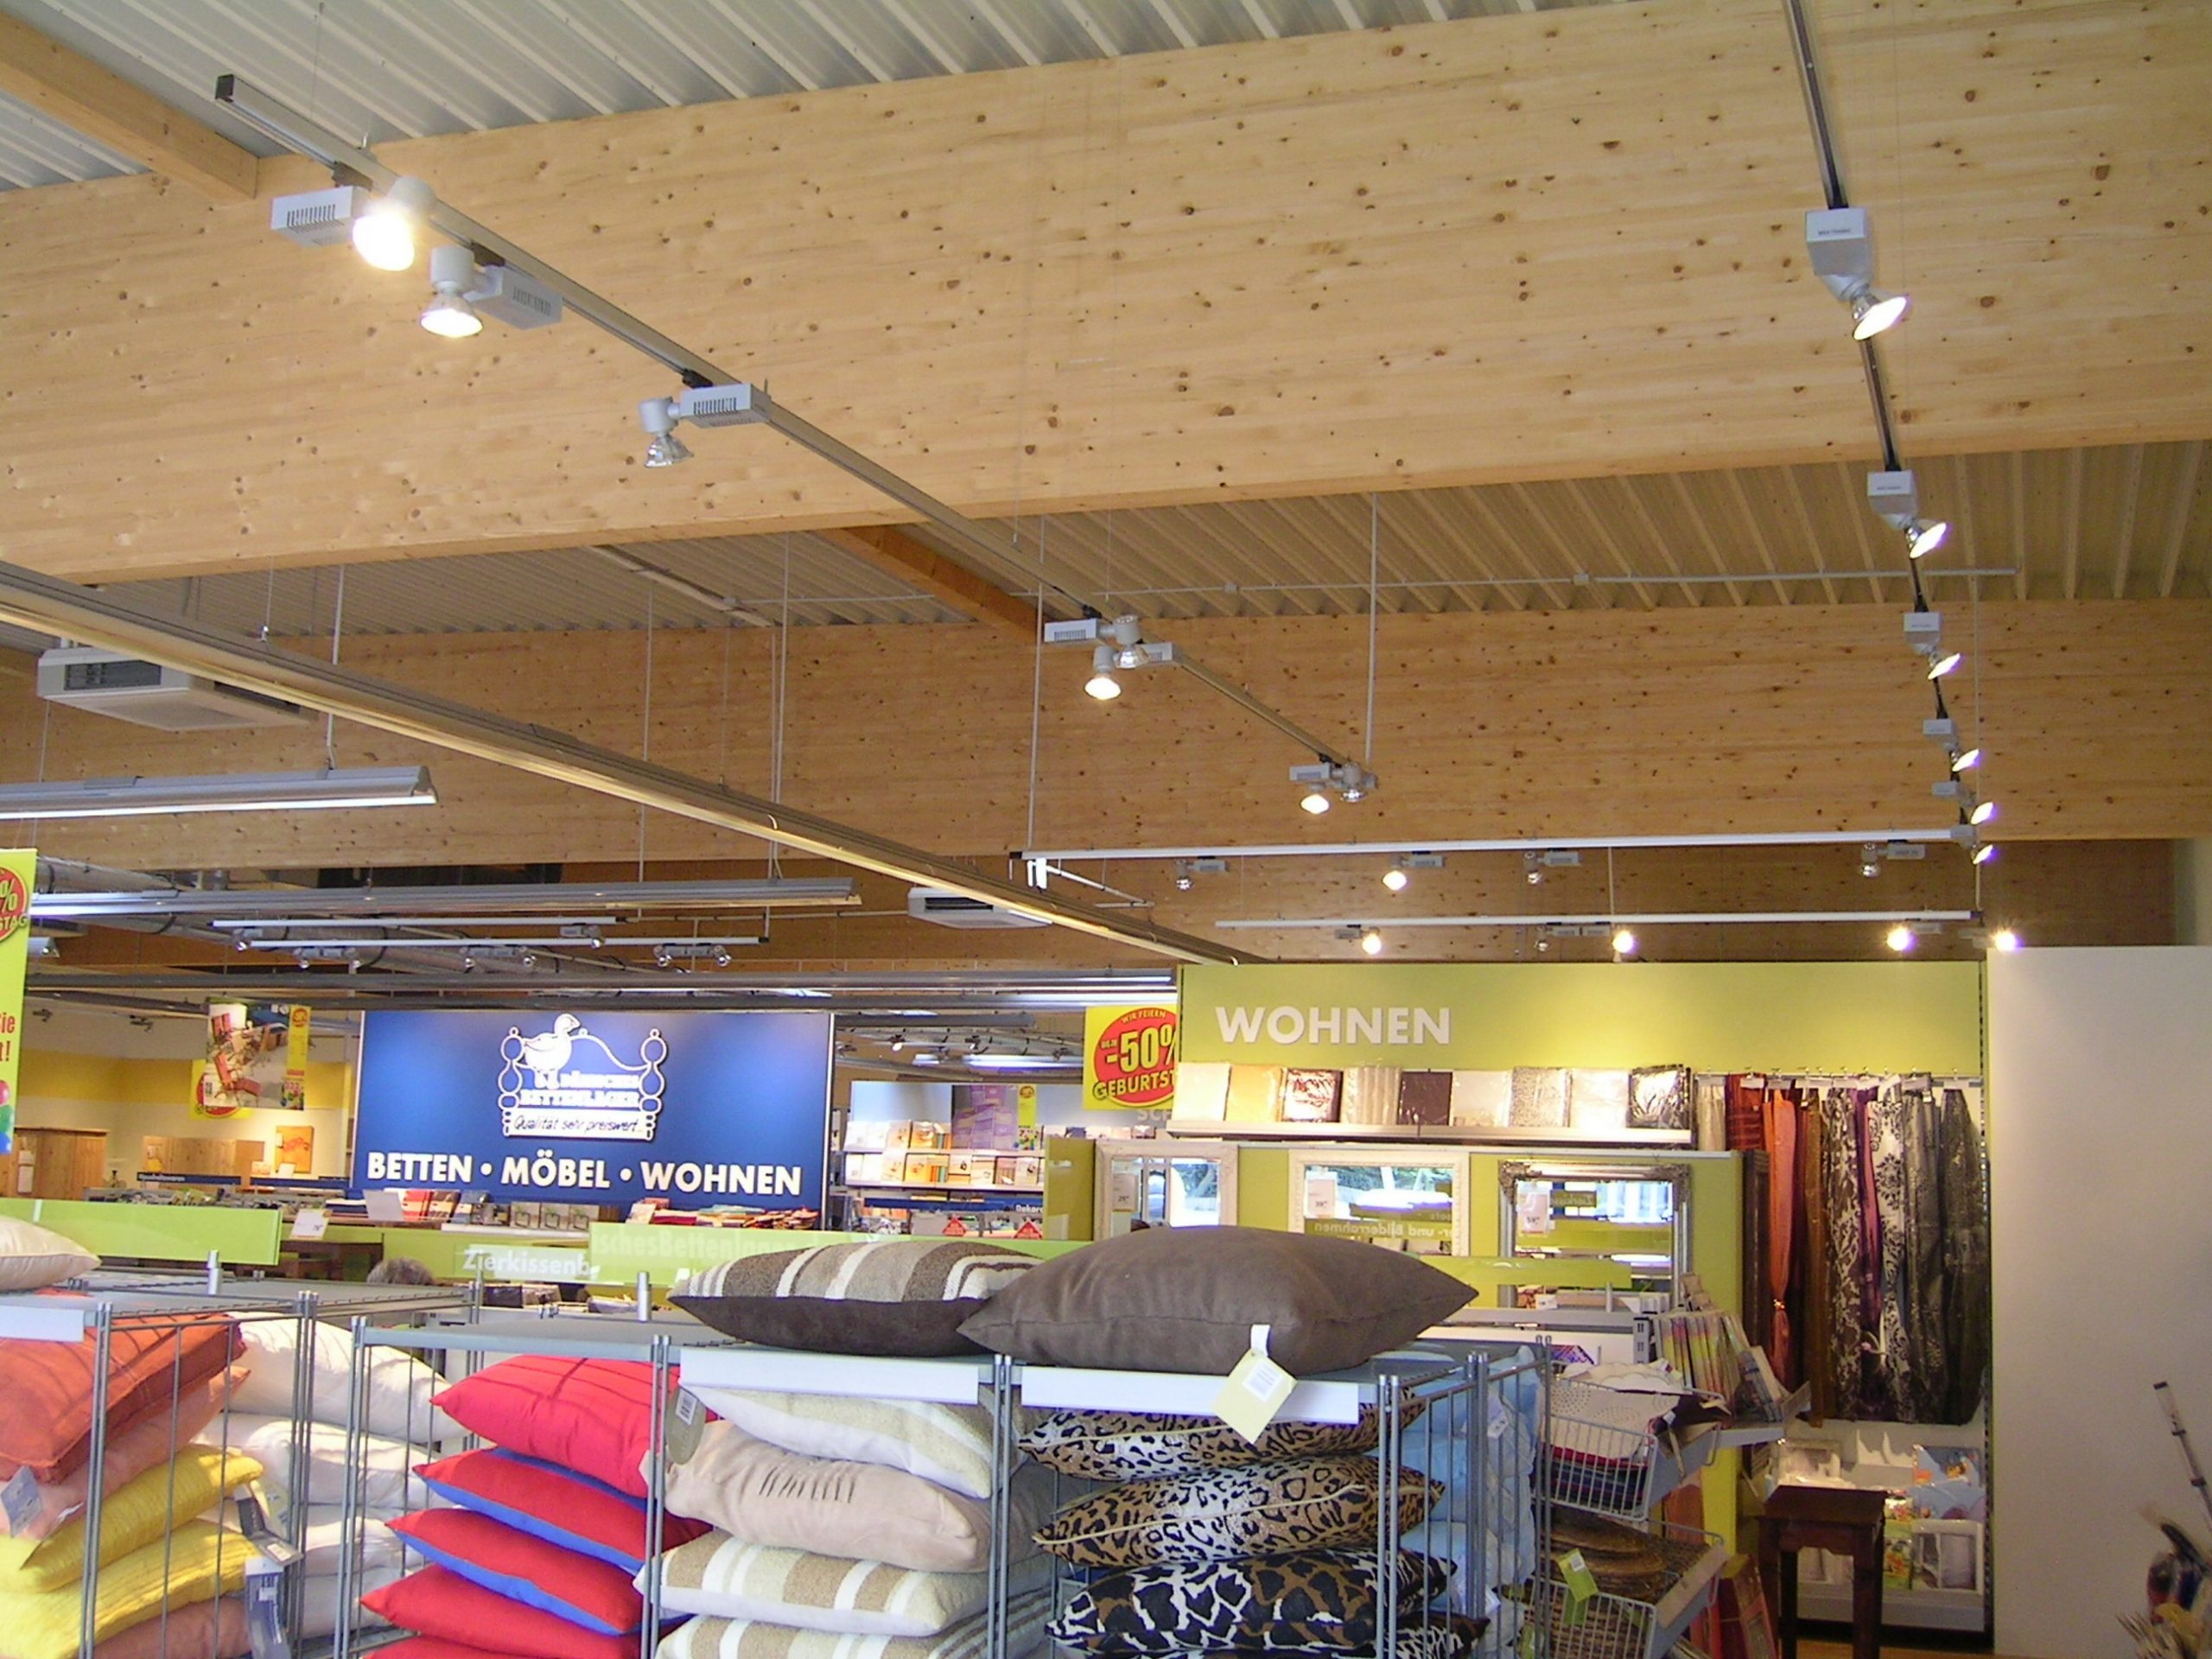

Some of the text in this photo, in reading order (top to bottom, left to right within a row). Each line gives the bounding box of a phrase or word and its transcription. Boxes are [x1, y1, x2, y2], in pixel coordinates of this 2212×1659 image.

[0, 1011, 16, 1033] ie
[1215, 1006, 1451, 1045] WOHNEN
[367, 1149, 801, 1196] BETTEN MÖBEL WOHNEN
